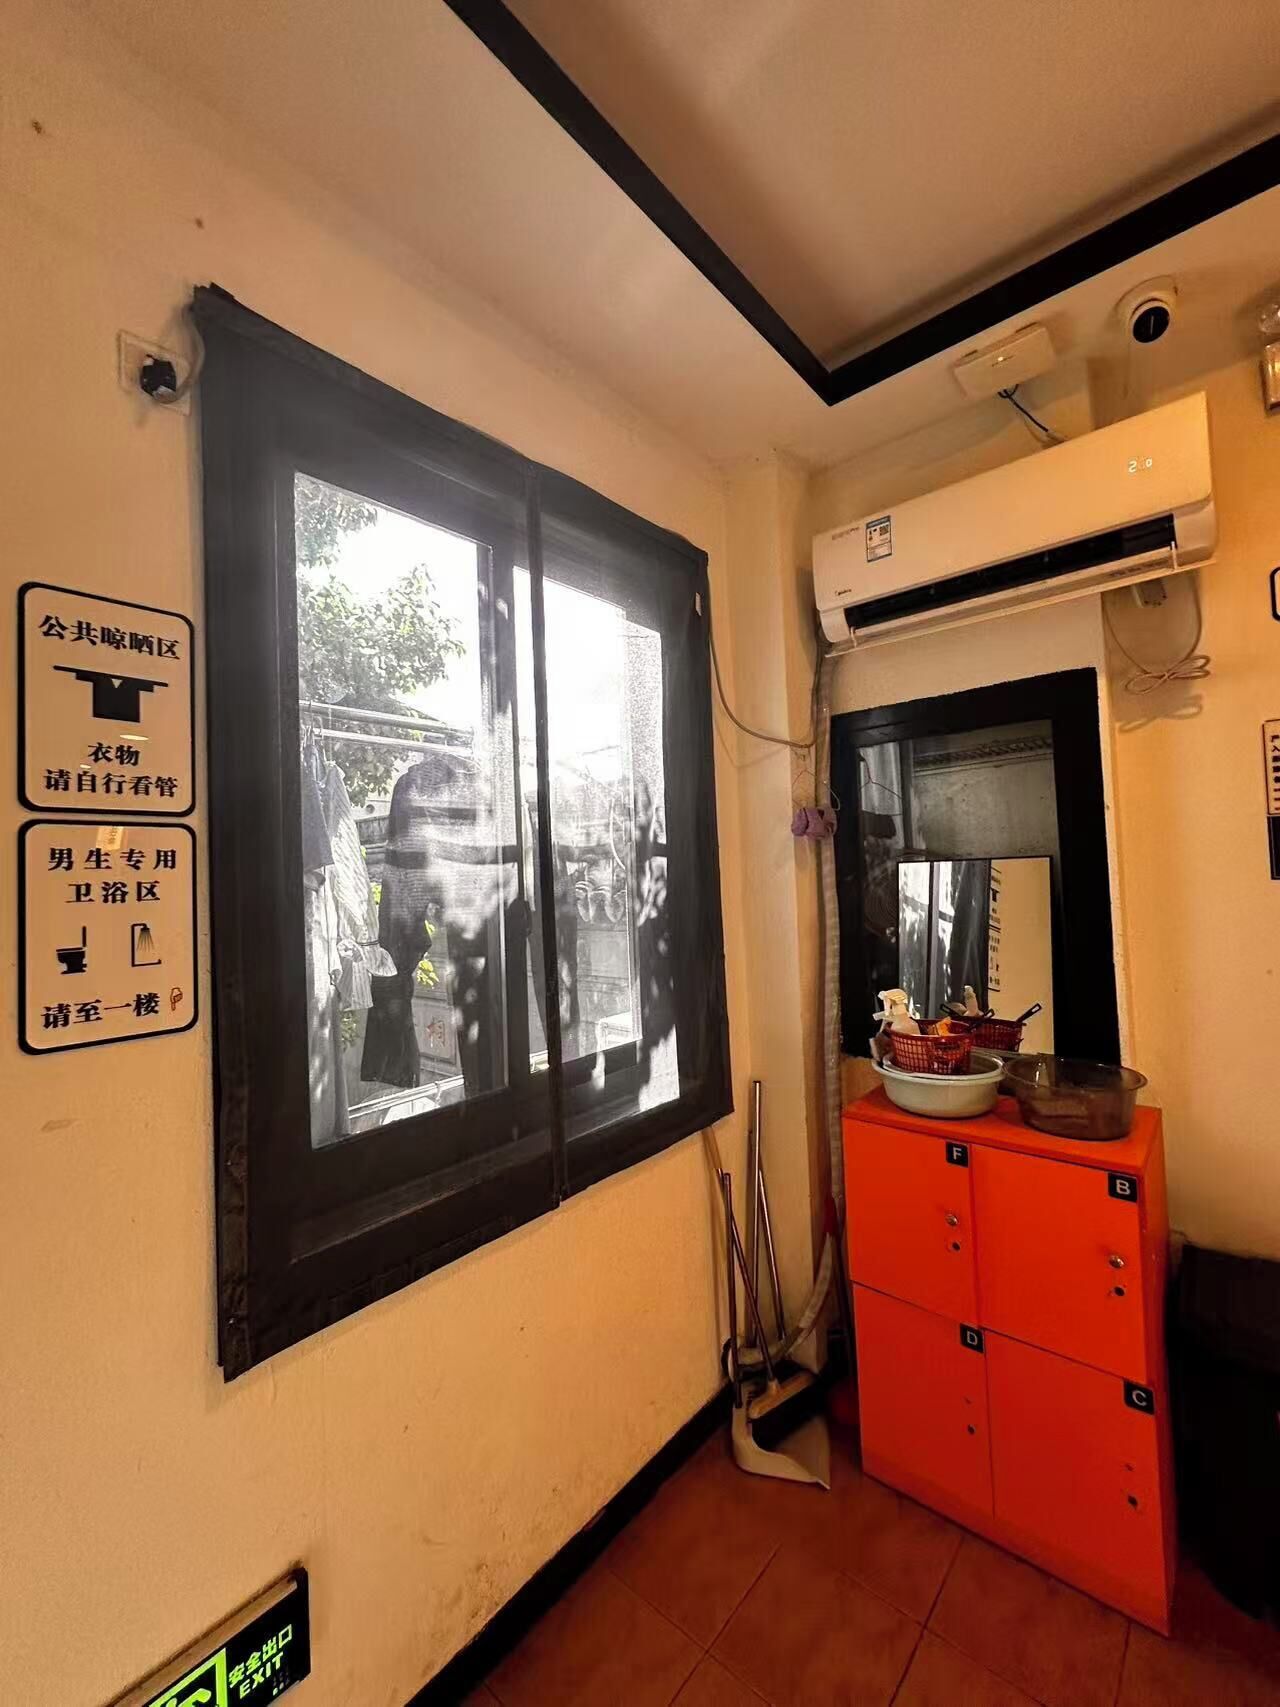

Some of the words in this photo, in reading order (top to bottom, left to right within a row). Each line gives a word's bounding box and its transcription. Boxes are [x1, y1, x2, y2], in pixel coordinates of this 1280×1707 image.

[38, 614, 181, 660] 公共晾晒区
[87, 742, 141, 767] 衣物
[43, 769, 179, 798] 请自行看管
[48, 847, 176, 871] 男生专用
[65, 880, 161, 904] 卫浴区
[41, 992, 161, 1029] 请至一楼
[952, 1147, 962, 1160] F
[1116, 1179, 1131, 1196] B
[966, 1330, 978, 1346] D
[1131, 1390, 1148, 1407] C
[228, 1624, 292, 1688] 安全出口
[240, 1652, 283, 1699] EXIT
